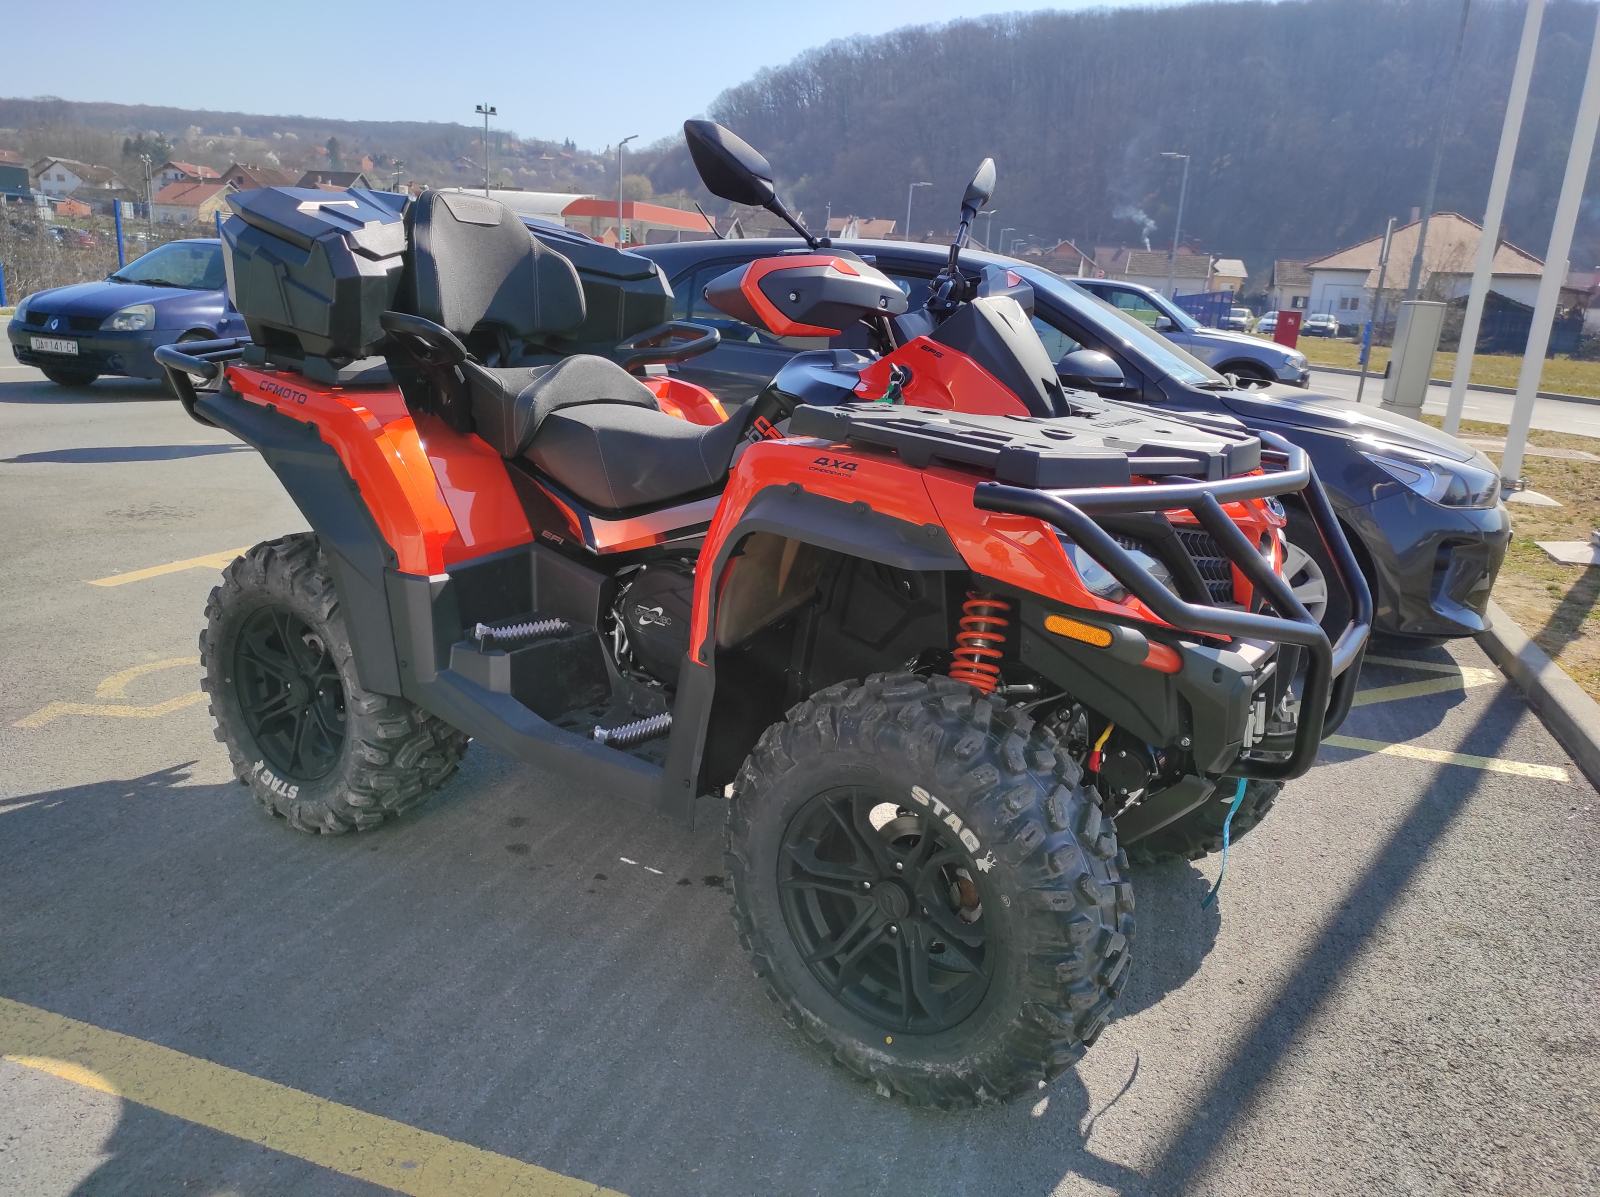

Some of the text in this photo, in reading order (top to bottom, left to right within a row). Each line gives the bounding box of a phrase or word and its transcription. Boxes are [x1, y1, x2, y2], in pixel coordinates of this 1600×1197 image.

[259, 380, 308, 404] CFMOTO
[541, 530, 564, 544] EFI
[260, 769, 299, 799] STAG
[911, 784, 980, 854] STAG
